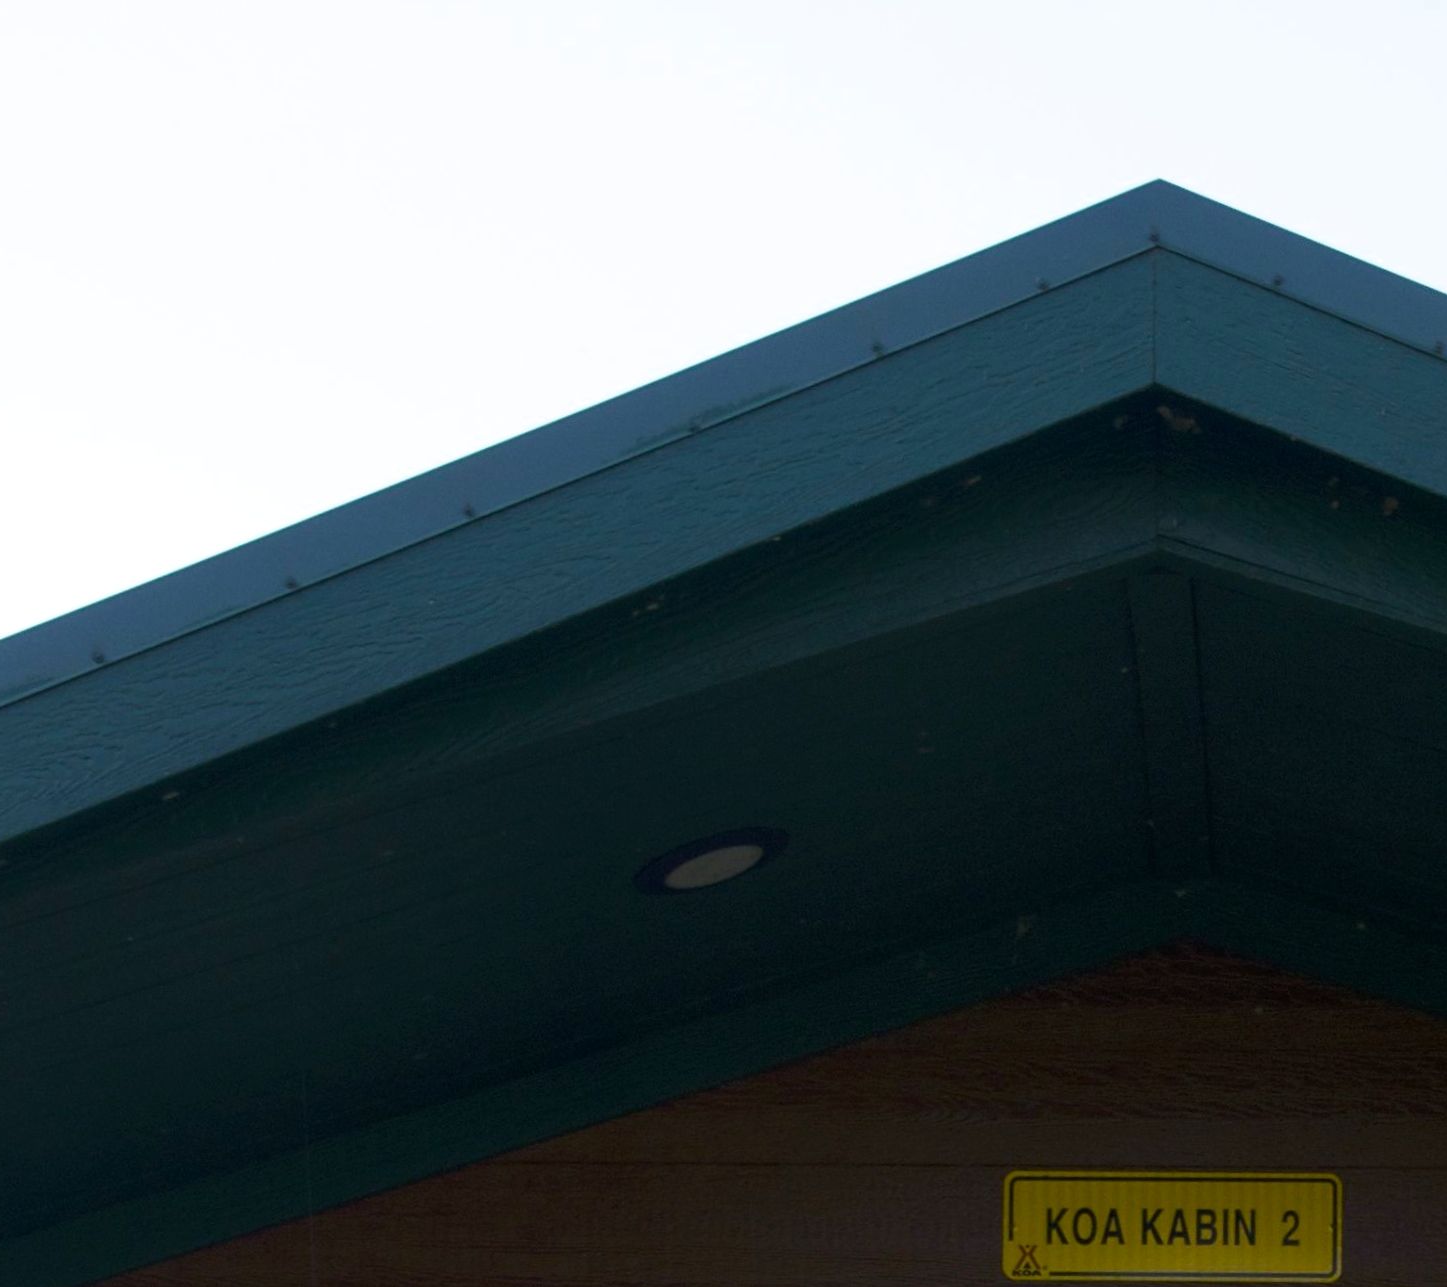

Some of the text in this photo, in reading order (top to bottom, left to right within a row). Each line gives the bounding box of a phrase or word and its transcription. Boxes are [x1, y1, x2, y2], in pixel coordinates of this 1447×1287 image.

[1046, 1207, 1301, 1247] KOA KABIN 2
[1011, 1269, 1042, 1277] KOA
